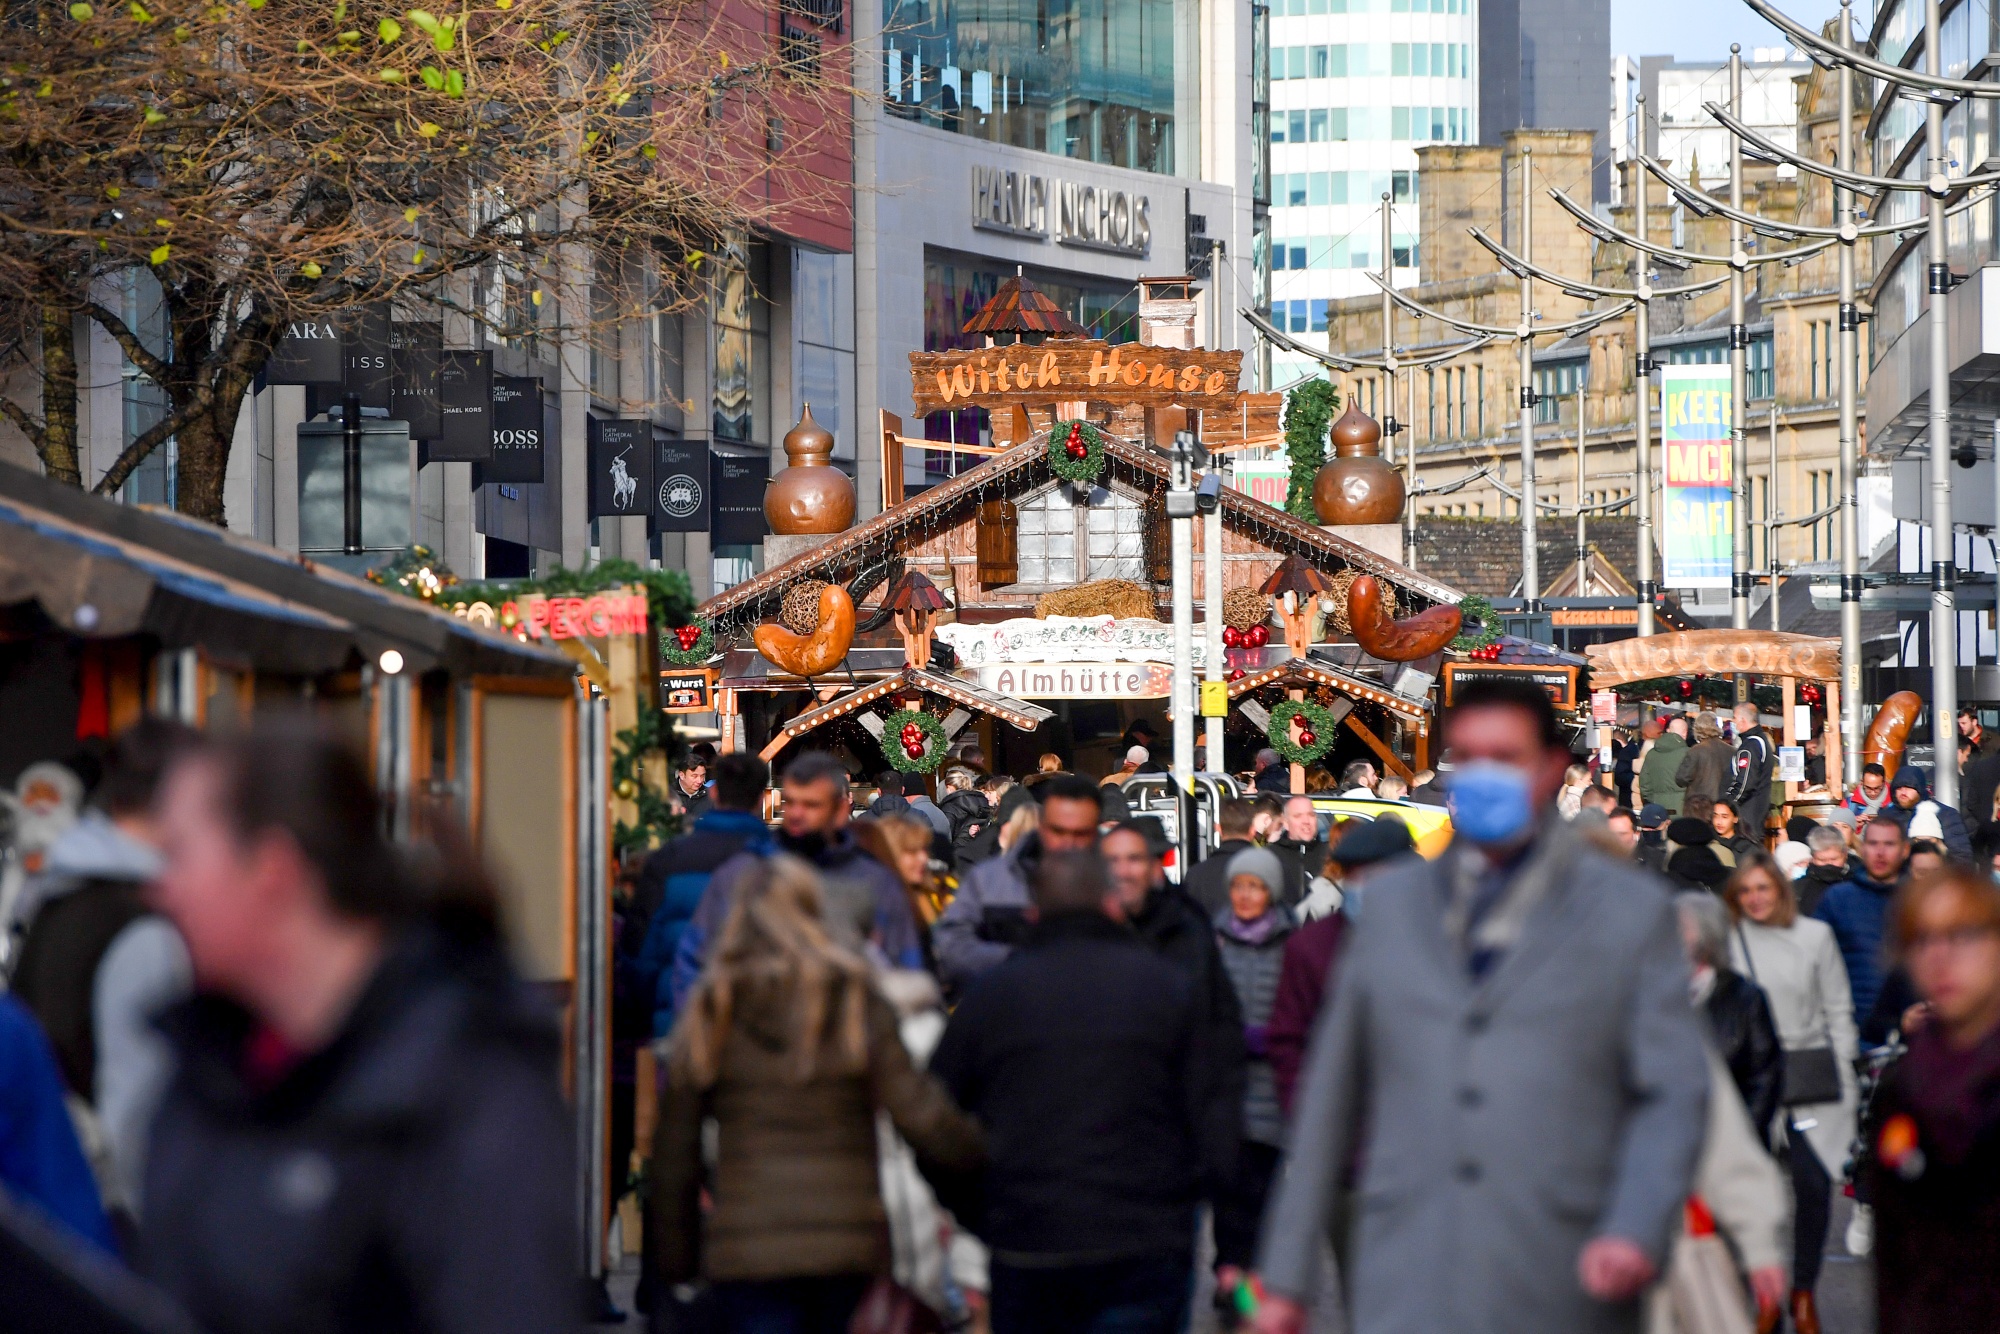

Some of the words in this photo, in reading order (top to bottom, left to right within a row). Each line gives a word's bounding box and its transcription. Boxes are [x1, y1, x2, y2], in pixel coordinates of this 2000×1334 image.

[972, 164, 1049, 234] HARVEY
[1055, 178, 1150, 251] NICHOLS
[283, 322, 337, 339] ARA
[403, 388, 434, 396] BAKER
[936, 351, 1061, 403] Witch
[1088, 348, 1226, 397] House
[529, 596, 647, 640] PERONI
[1608, 633, 1818, 681] Welcome
[670, 679, 704, 689] Wurst
[997, 668, 1142, 694] Almhütte
